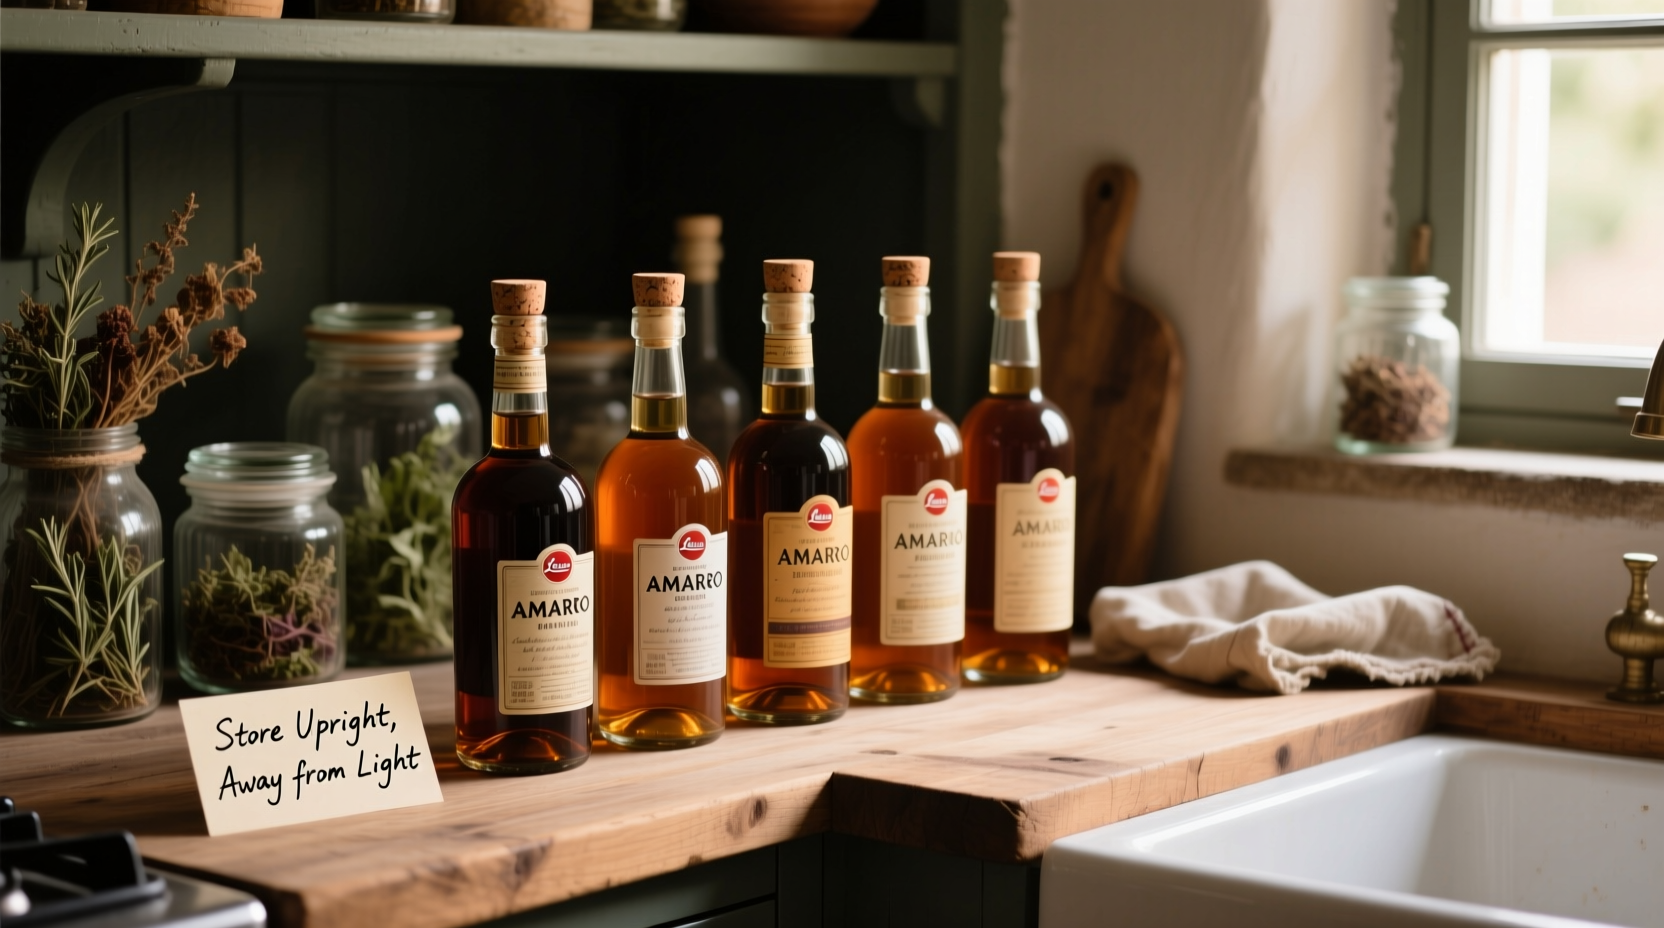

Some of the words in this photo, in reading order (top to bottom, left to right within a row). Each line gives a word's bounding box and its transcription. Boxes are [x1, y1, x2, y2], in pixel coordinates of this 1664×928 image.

[1012, 518, 1070, 537] AMAR
[215, 717, 284, 751] Store
[296, 700, 396, 751] Upright,
[218, 765, 282, 805] Away
[292, 759, 346, 800] from
[357, 743, 421, 789] Light
